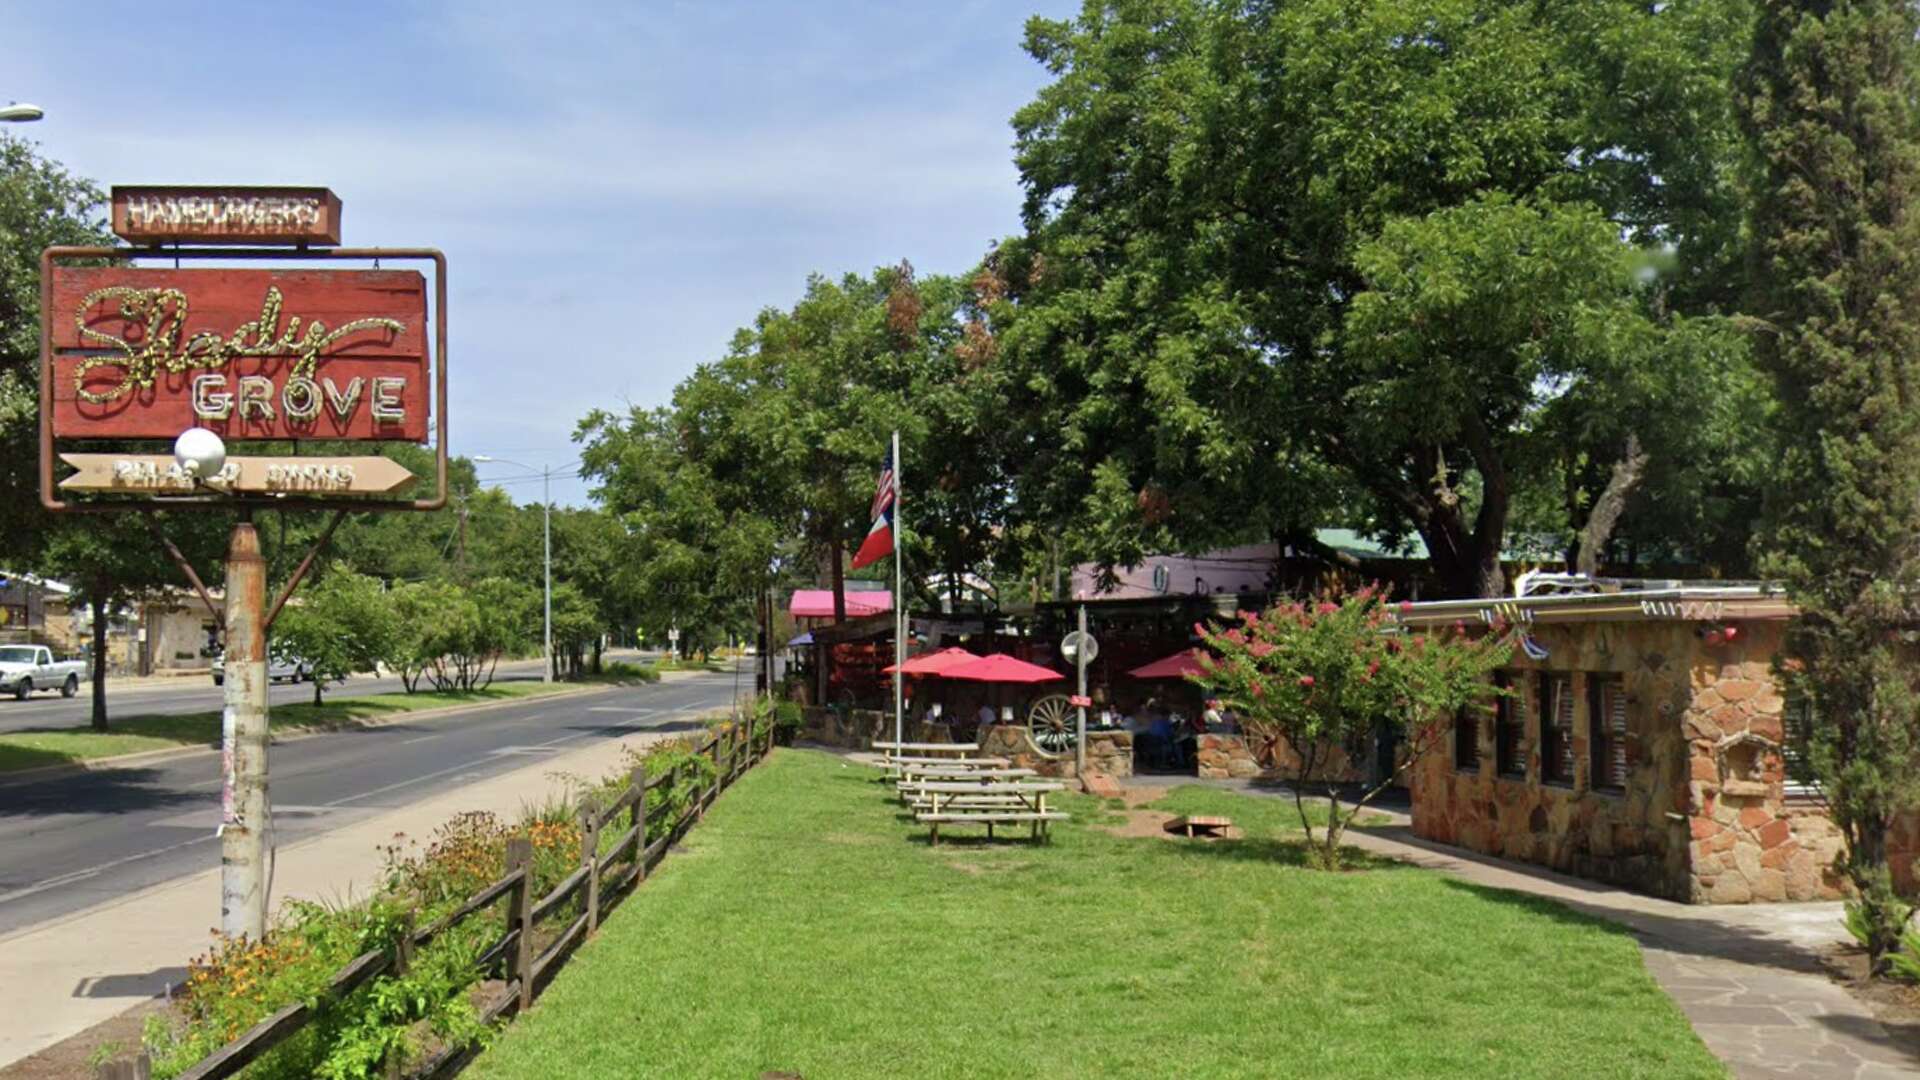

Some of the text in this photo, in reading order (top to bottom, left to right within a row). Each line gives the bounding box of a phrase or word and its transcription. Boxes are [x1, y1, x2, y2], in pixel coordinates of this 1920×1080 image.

[126, 196, 320, 225] HAMBURGERS
[75, 285, 406, 403] Shady
[192, 374, 406, 424] GROVE
